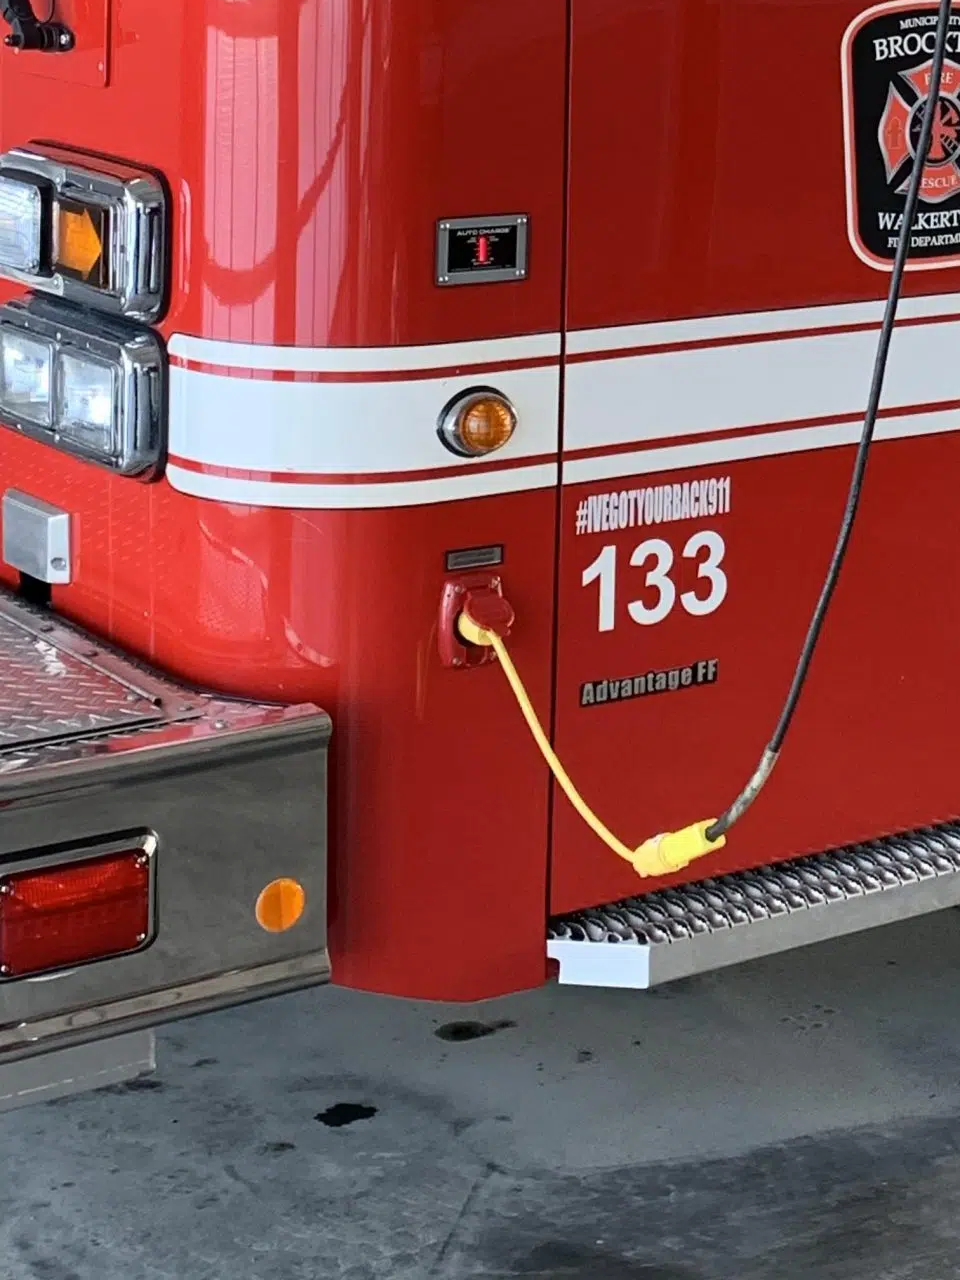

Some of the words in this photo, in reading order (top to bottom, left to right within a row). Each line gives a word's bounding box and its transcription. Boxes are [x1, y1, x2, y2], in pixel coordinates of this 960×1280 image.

[575, 476, 731, 536] #IVEGOTYOURBACK911
[581, 529, 728, 632] 133
[581, 666, 693, 706] Advantage
[696, 658, 718, 683] FF
